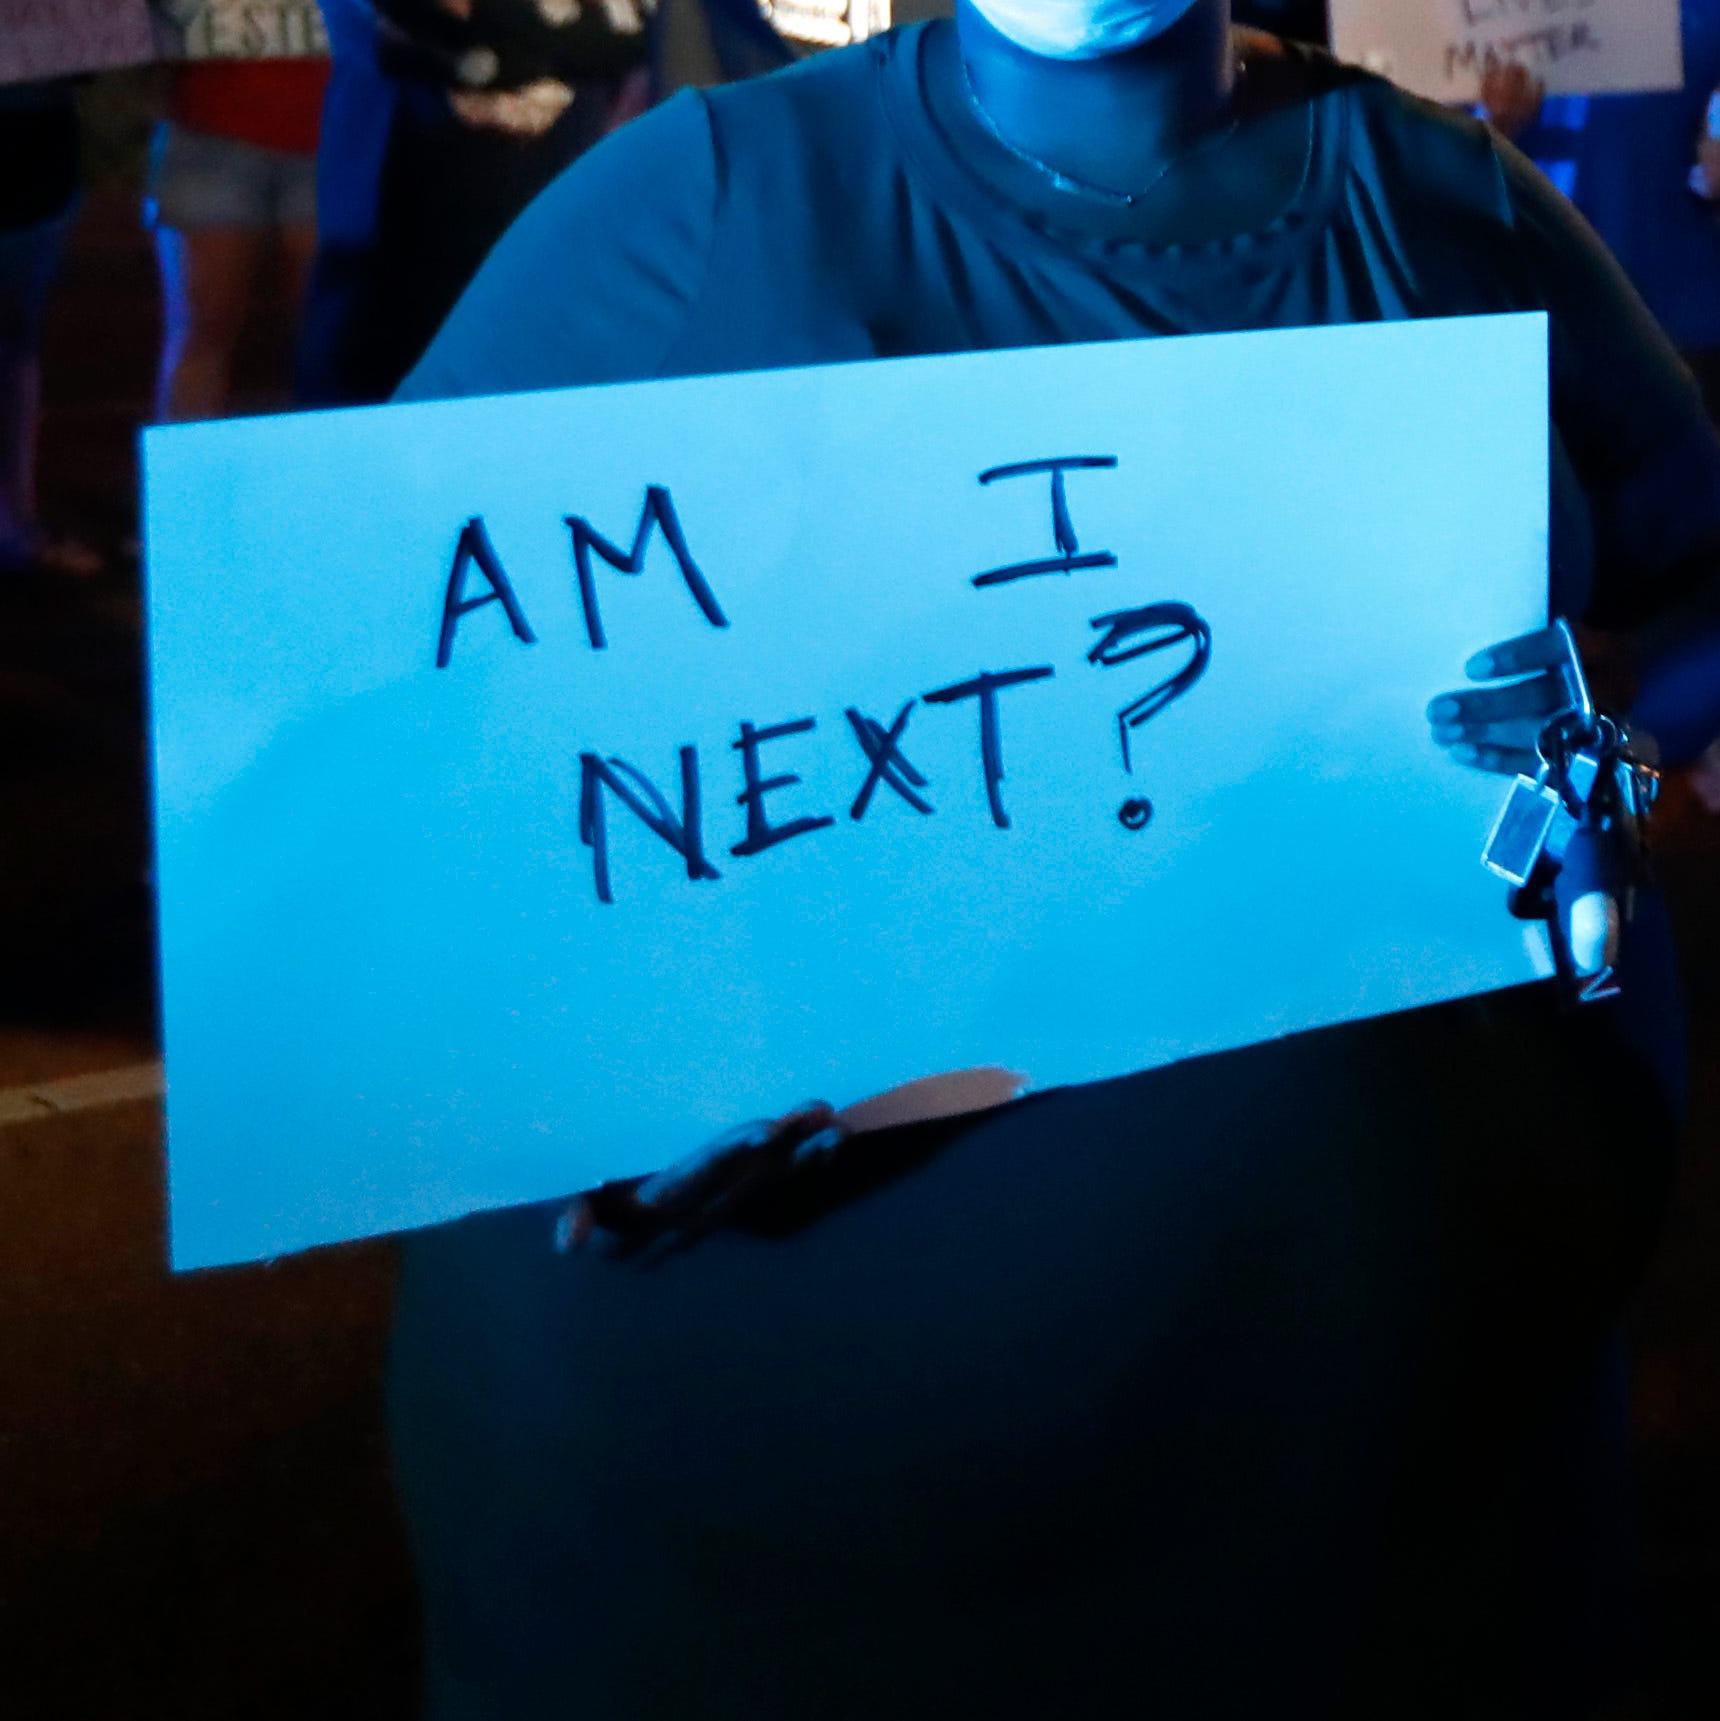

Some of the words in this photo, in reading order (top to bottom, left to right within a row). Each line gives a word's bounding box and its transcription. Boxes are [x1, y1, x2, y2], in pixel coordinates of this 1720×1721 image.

[435, 486, 728, 670] AM
[971, 455, 1118, 587] I
[578, 600, 1213, 905] NEXT?
